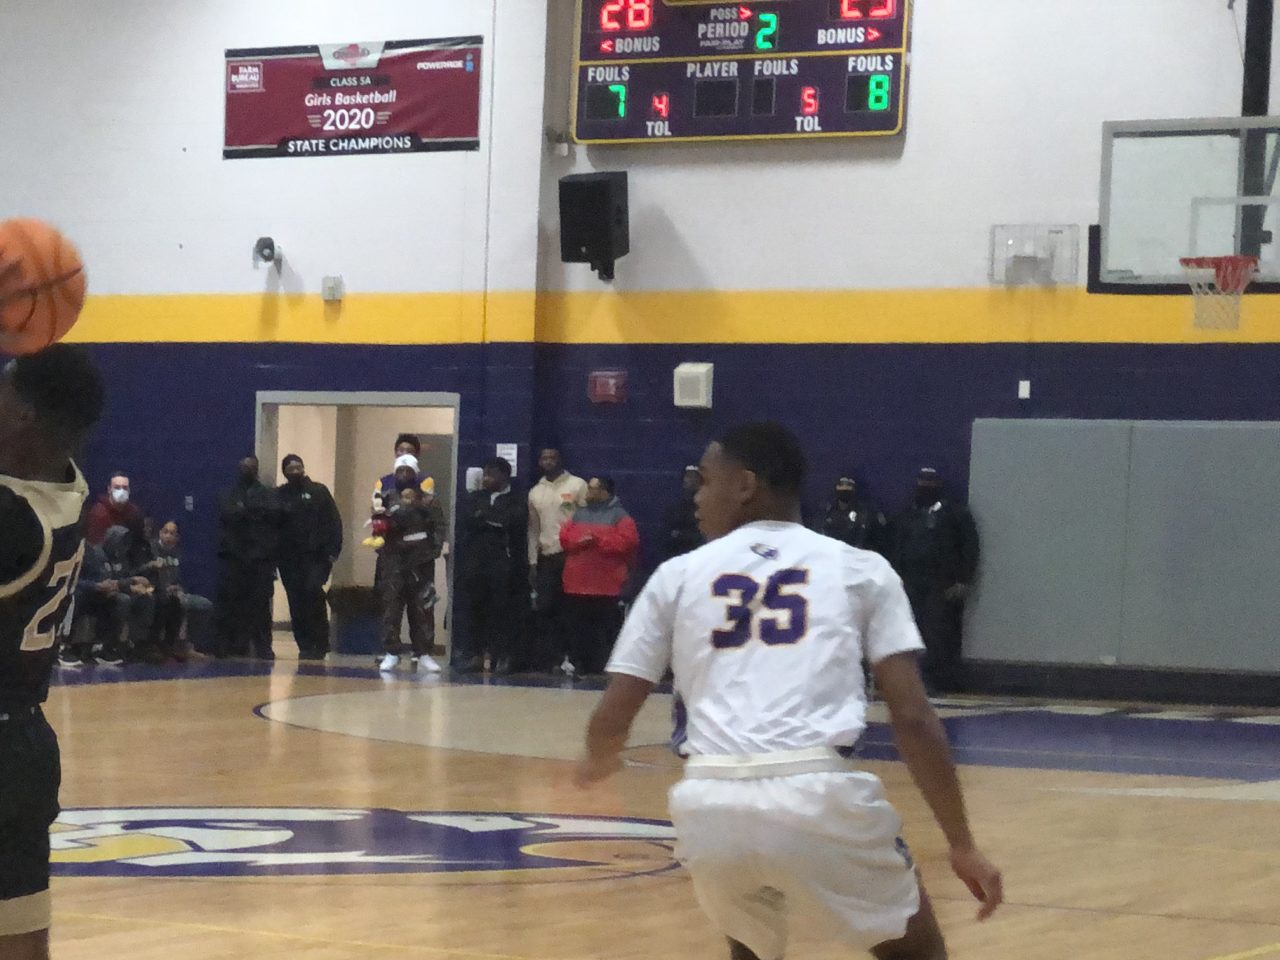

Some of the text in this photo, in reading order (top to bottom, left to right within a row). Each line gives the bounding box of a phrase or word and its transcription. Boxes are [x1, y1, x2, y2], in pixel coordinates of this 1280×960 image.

[710, 7, 738, 20] POSS
[698, 21, 749, 38] PERIOD
[756, 13, 777, 49] 2
[817, 27, 865, 45] BONUS
[615, 36, 660, 53] BONUS
[686, 58, 799, 78] PLAYER FOULS
[847, 54, 894, 72] FOULS
[330, 77, 357, 87] CLASS
[587, 65, 630, 82] FOULS
[304, 89, 397, 107] Girls Basketball
[608, 84, 626, 118] 7
[868, 74, 890, 111] 8
[652, 92, 669, 118] 4
[322, 107, 376, 131] 2020
[795, 116, 822, 132] TOL
[646, 121, 672, 136] TOL
[287, 135, 412, 153] STATE CHAMPIONS
[710, 567, 809, 649] 35
